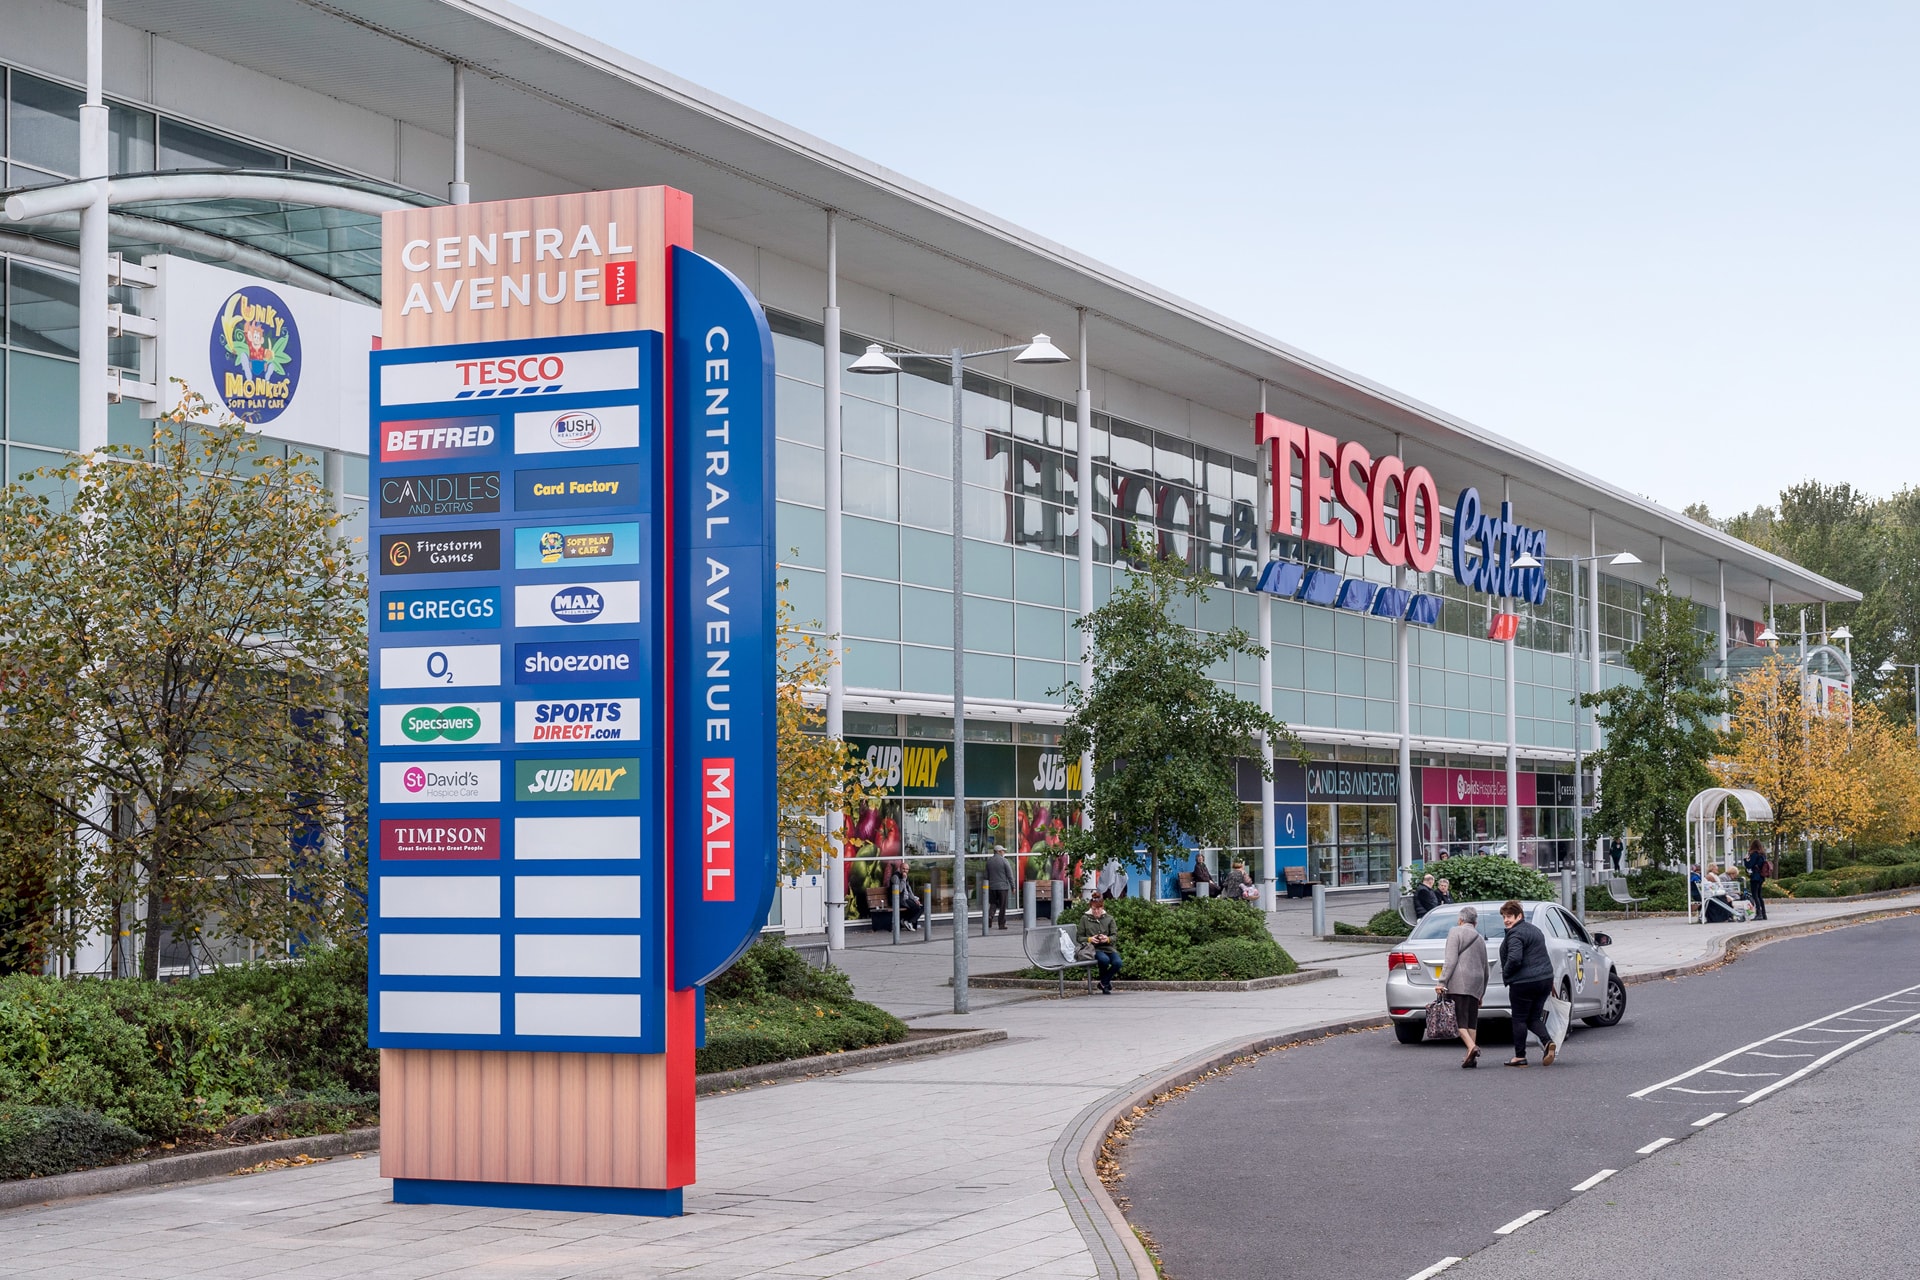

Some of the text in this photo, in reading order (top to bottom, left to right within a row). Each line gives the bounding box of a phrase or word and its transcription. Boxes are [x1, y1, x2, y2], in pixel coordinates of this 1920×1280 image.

[402, 222, 633, 271] CENTRAL
[401, 268, 600, 316] AVENUE
[616, 266, 625, 302] MALL
[455, 356, 564, 387] TESCO
[225, 372, 291, 399] MONKEYS
[228, 399, 245, 409] SOFT
[248, 399, 266, 409] PLAY
[557, 419, 594, 433] BUSH
[386, 425, 495, 452] BETFRED
[382, 475, 500, 505] CANDLES
[533, 480, 619, 497] Card Factory
[1255, 412, 1441, 573] TESCO
[408, 502, 474, 515] AND EXTRAS
[416, 540, 483, 553] Firestorm
[567, 538, 587, 547] SOFT
[589, 536, 610, 546] PLAY
[1452, 487, 1548, 606] extra
[430, 552, 474, 564] Games
[409, 598, 494, 620] GREGGS
[555, 594, 600, 609] MAX
[705, 326, 731, 891] CENTRAL AVENUE MALL
[524, 651, 629, 673] shoezone
[534, 702, 621, 723] SPORTS
[408, 717, 474, 733] Specsavers
[533, 724, 621, 740] DIRECT.COM
[860, 744, 948, 788] SUBWAY
[1033, 752, 1083, 792] SUBW
[406, 771, 479, 788] St David's
[528, 766, 627, 794] SUBWAY
[1307, 769, 1351, 795] CANDLES
[1372, 772, 1401, 796] EXTRA
[427, 788, 479, 798] Hospice Care
[394, 827, 487, 844] TIMPSON
